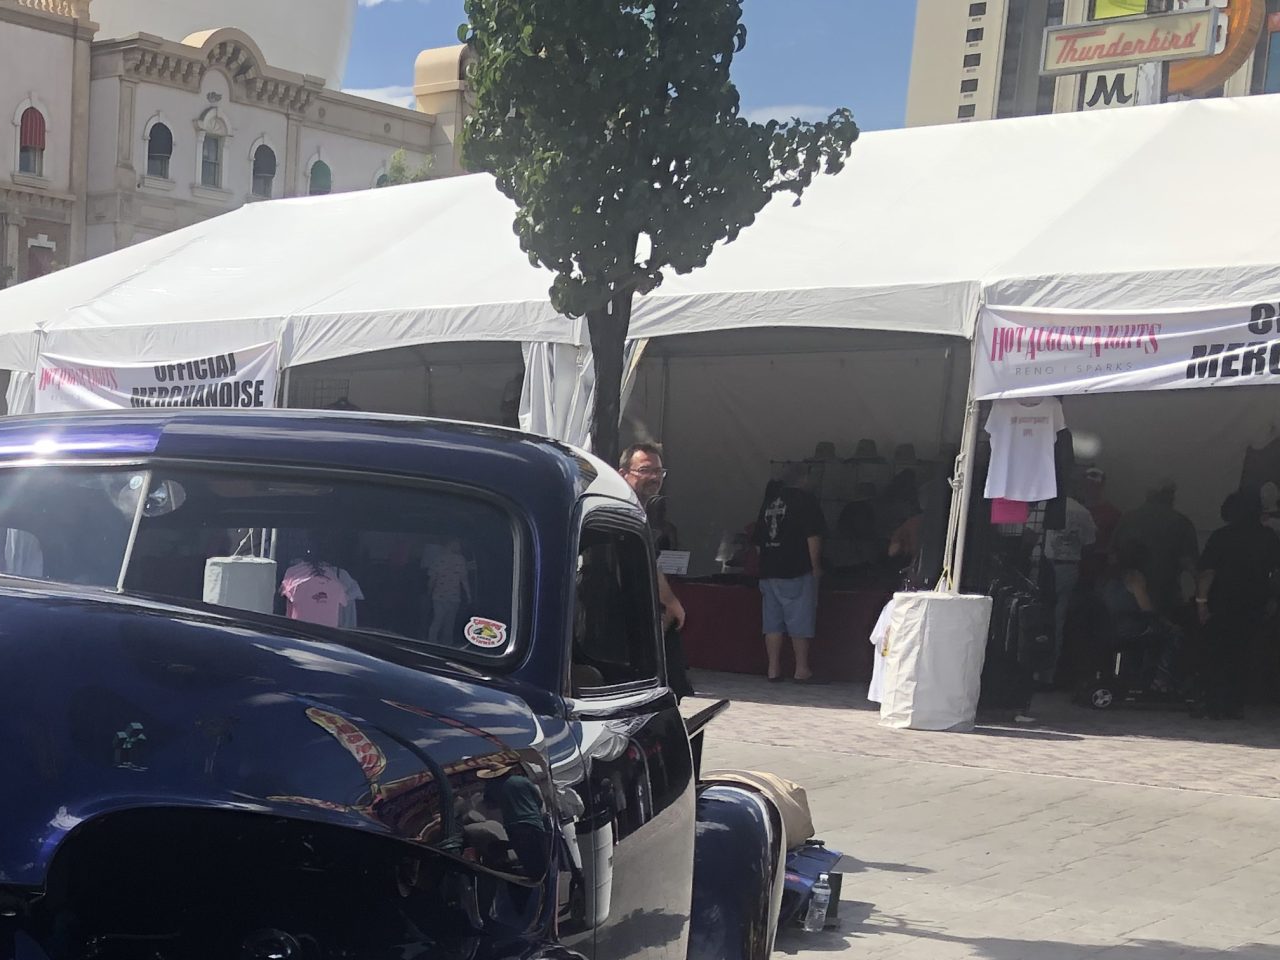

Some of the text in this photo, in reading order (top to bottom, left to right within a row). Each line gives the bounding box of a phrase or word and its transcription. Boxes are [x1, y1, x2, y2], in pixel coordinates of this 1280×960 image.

[1055, 22, 1201, 64] Thunderbird
[1086, 73, 1132, 107] M
[991, 323, 1162, 361] HOT AUGUST NIGHTS
[1015, 361, 1133, 377] RENO SPARKS
